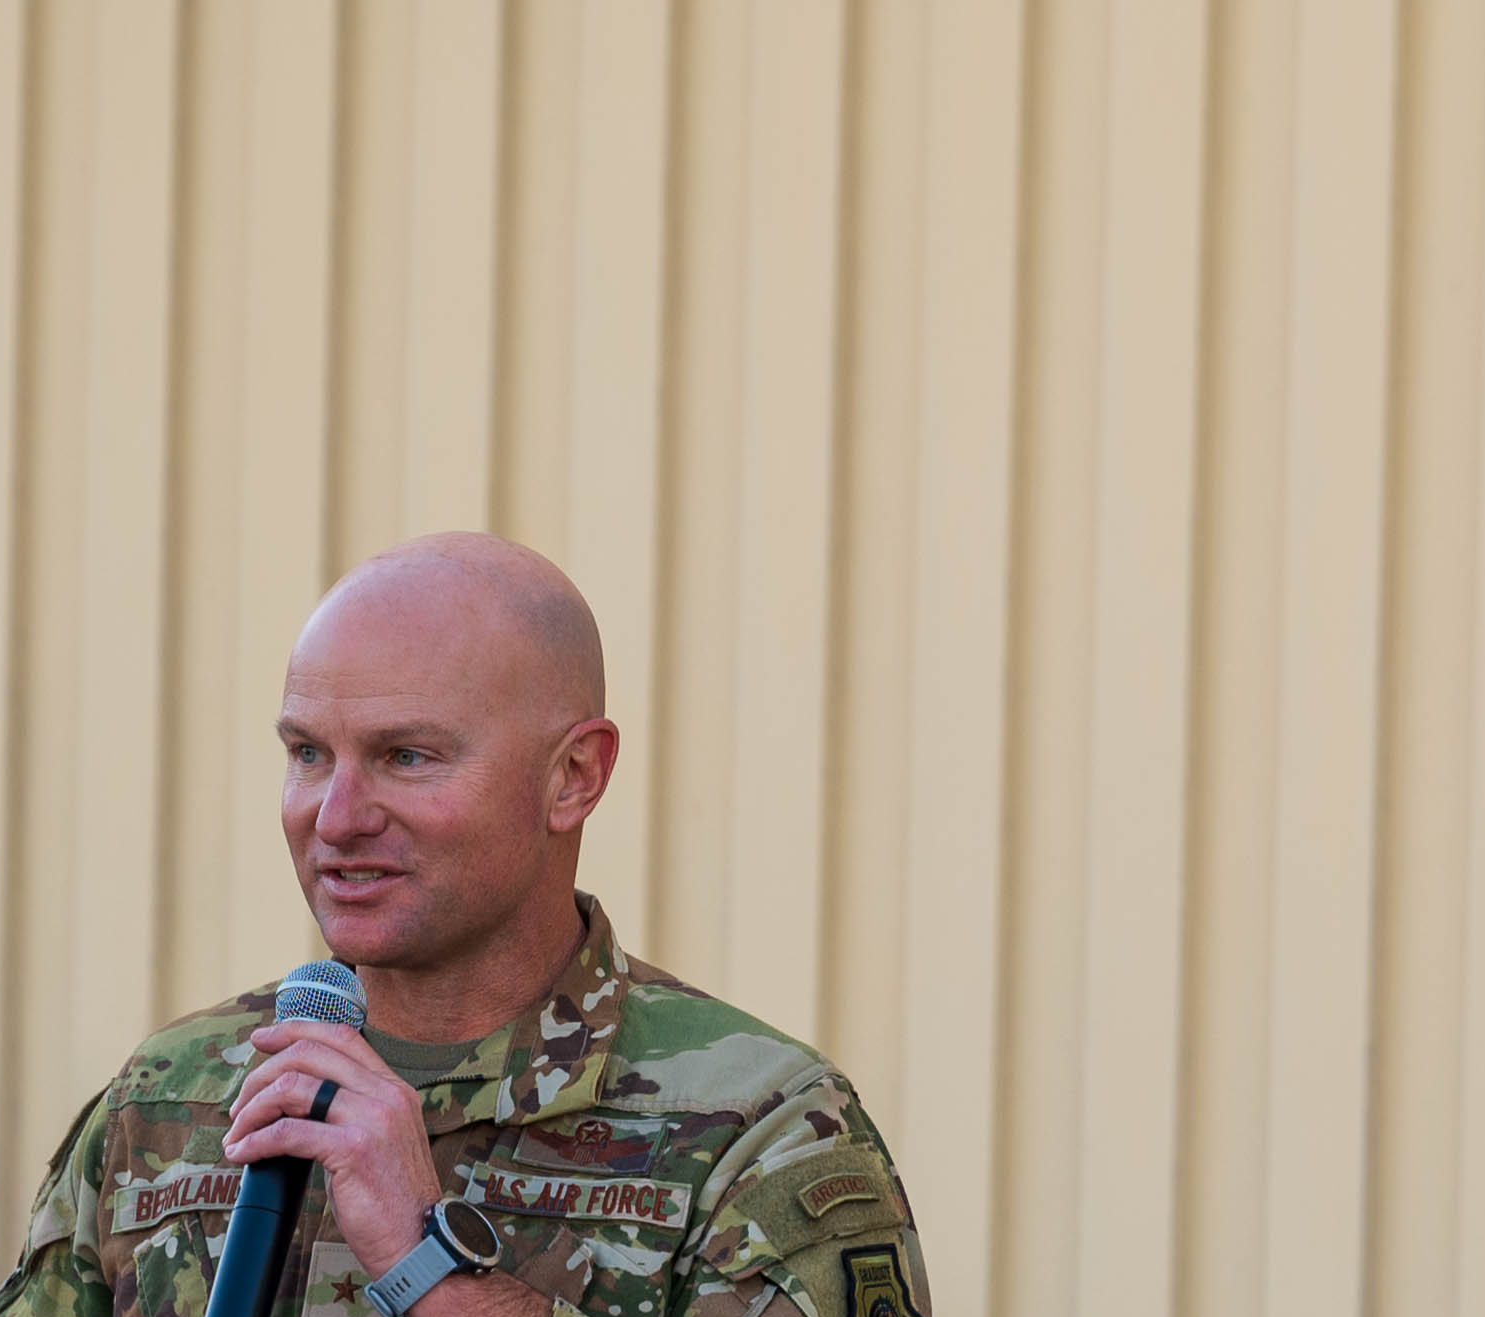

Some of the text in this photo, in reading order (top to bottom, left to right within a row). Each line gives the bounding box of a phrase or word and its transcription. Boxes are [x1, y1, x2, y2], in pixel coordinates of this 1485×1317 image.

[484, 1173, 673, 1222] U.S. AIR FORCE
[809, 1176, 867, 1208] ARCTIC
